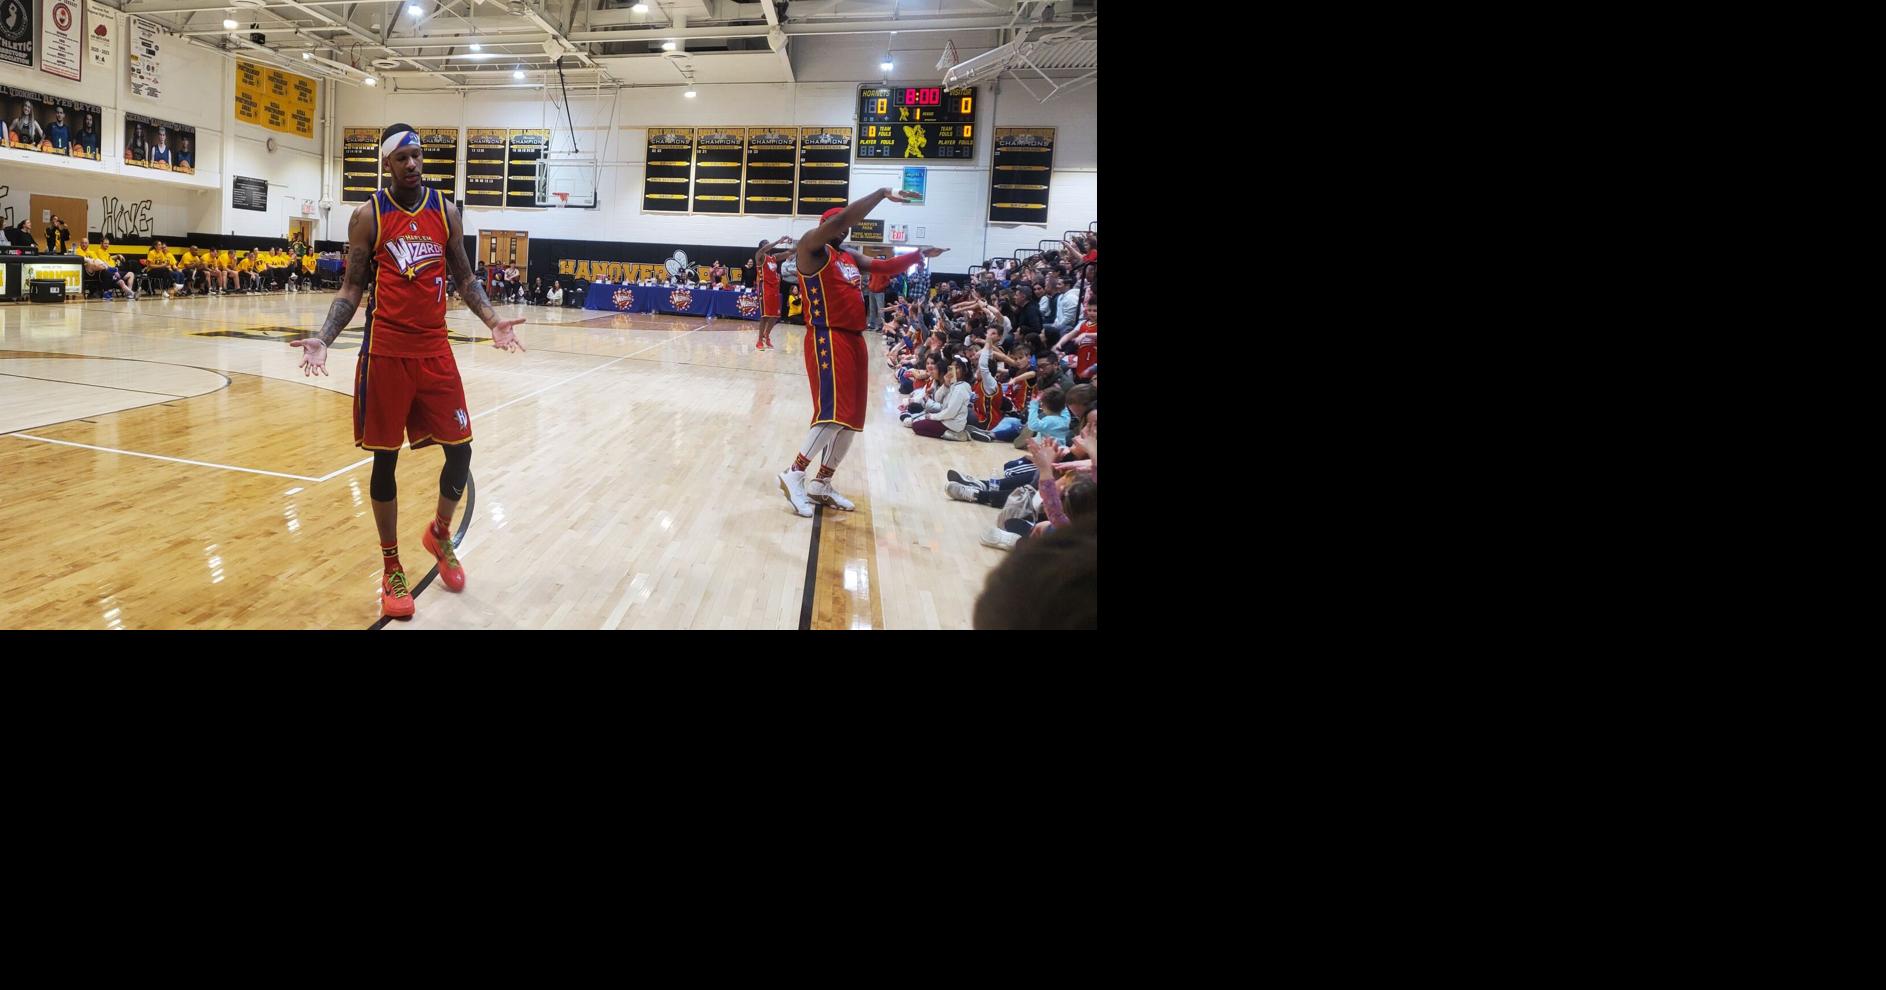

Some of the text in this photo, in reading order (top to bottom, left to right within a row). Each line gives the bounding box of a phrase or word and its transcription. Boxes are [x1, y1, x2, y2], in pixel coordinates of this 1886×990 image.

[0, 37, 32, 52] HLETIC
[862, 89, 890, 97] HORNETS
[905, 87, 940, 105] 8:00
[949, 88, 973, 96] VISITOR
[961, 97, 972, 114] 0
[916, 108, 920, 120] 1
[963, 125, 972, 137] 0
[892, 231, 904, 239] EXIT
[559, 259, 669, 282] HANOVER
[435, 276, 443, 303] 7
